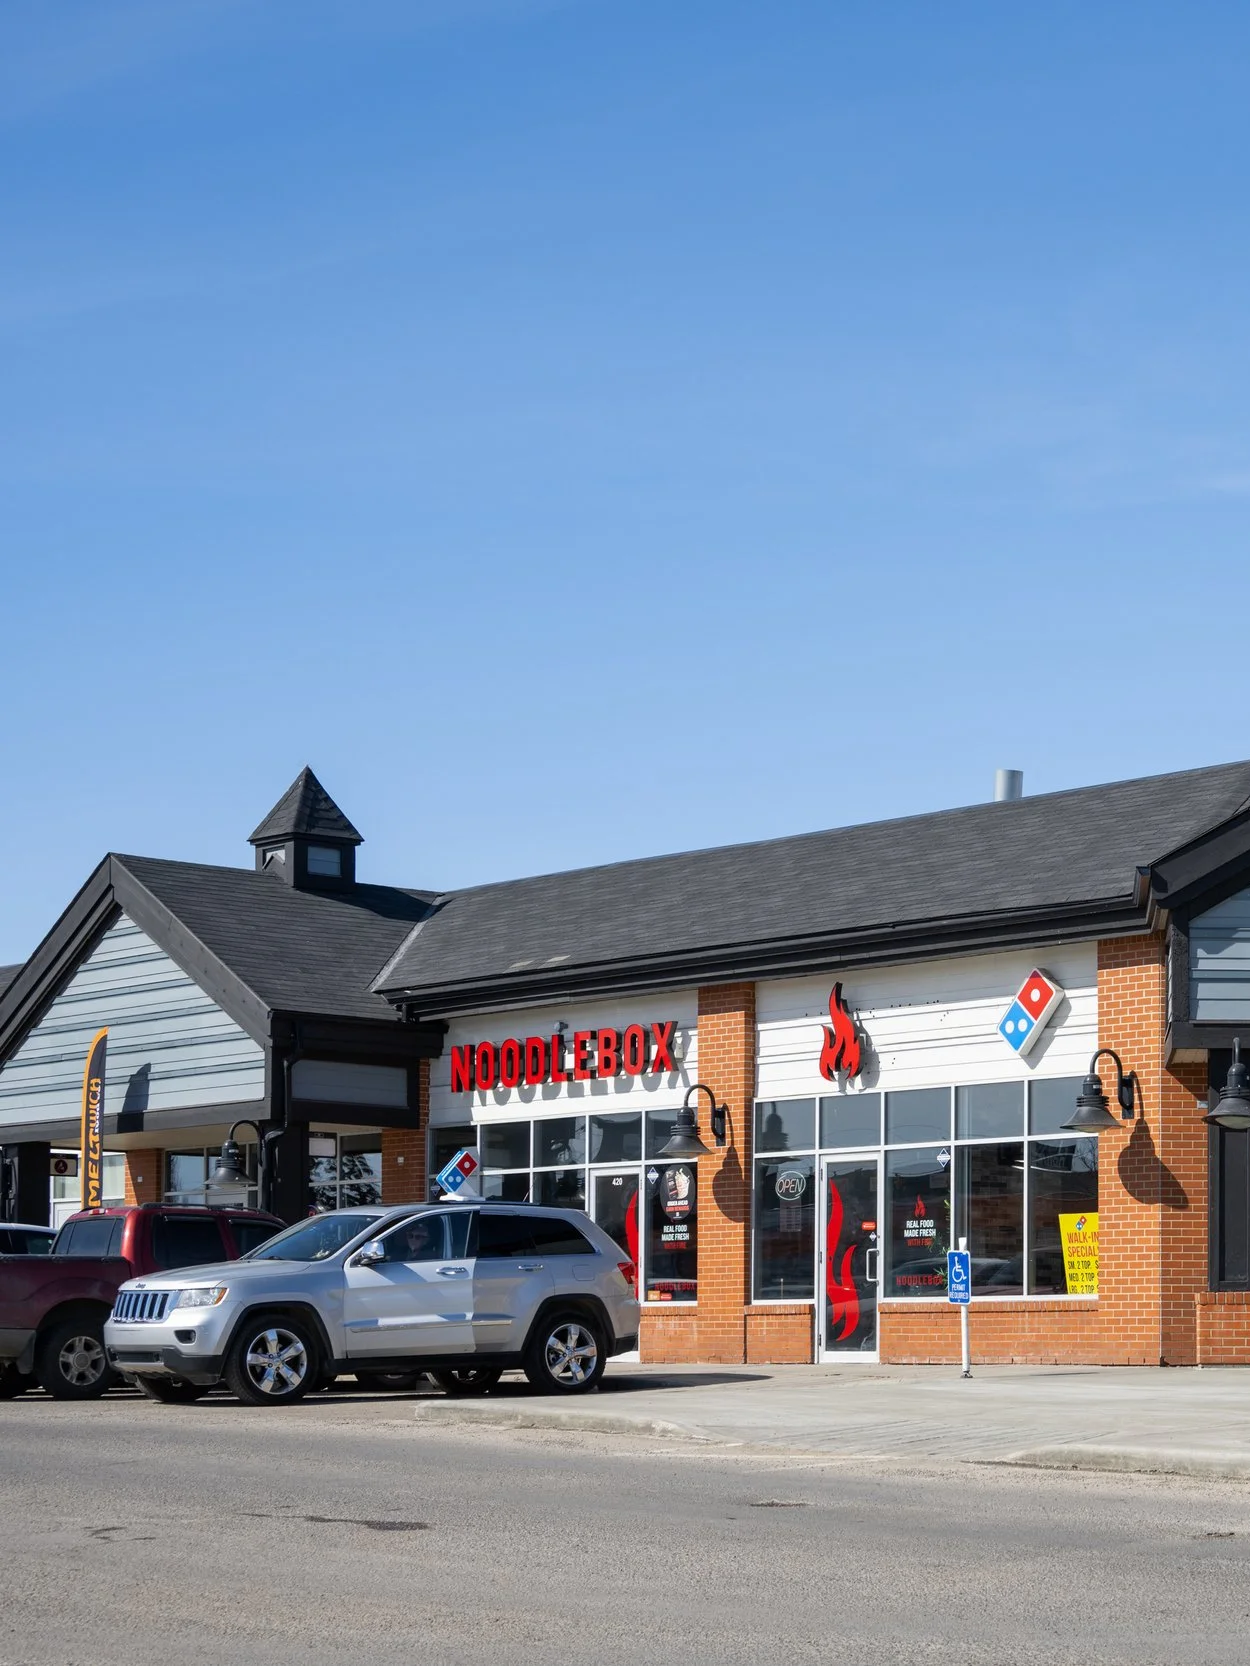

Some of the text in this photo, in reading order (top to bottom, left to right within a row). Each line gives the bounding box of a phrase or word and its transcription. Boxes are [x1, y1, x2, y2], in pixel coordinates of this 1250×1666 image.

[451, 1021, 678, 1093] NOODLEBOX
[88, 1078, 101, 1207] MELTWICH
[612, 1177, 623, 1186] 420
[778, 1179, 803, 1193] OPEN
[663, 1224, 687, 1233] REAL FOOD
[906, 1220, 933, 1228] REAL FOOD
[661, 1233, 689, 1241] MADE FRESH
[904, 1229, 936, 1238] MADE FRESH
[1067, 1231, 1099, 1244] WALK-IN
[1068, 1245, 1099, 1257] SPECIAL
[896, 1275, 943, 1286] NOODLEBOX
